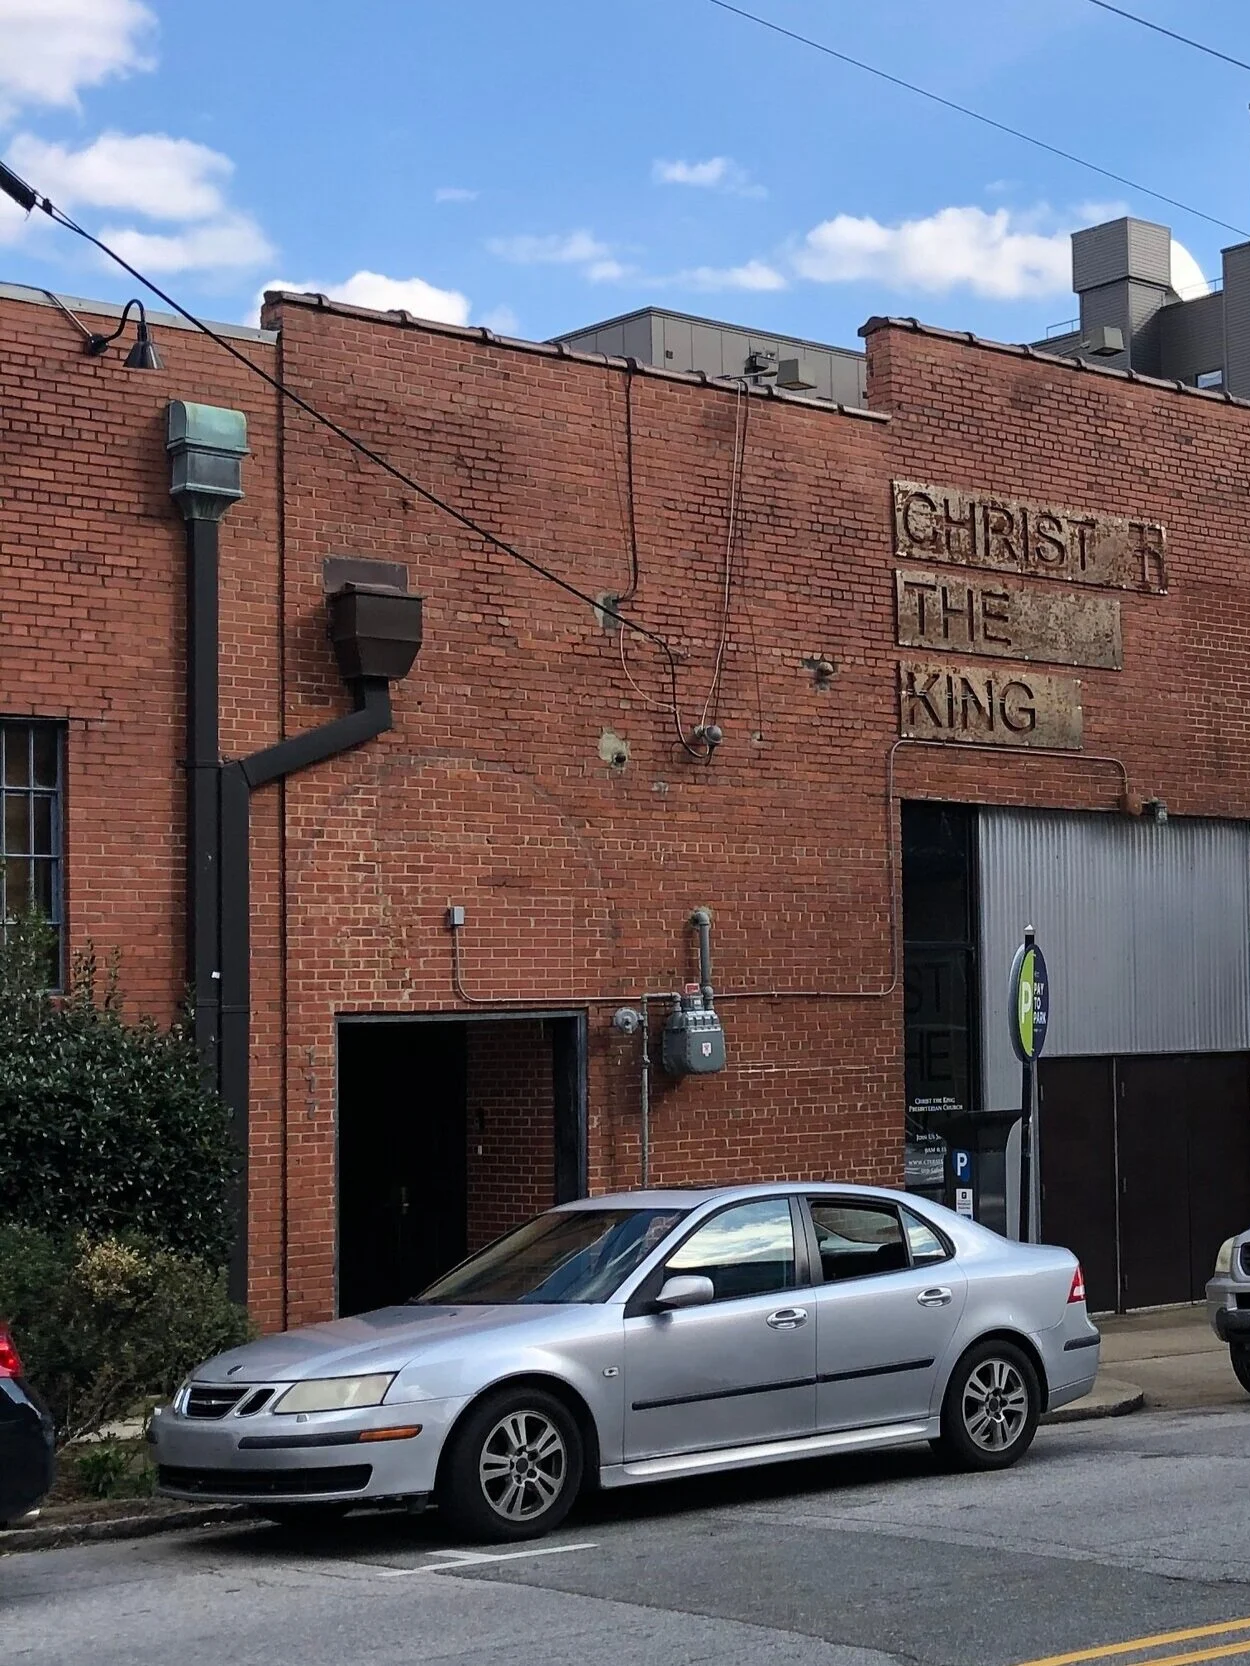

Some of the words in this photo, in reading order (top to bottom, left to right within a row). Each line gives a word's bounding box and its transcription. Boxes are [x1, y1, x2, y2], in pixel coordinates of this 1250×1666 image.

[903, 491, 1096, 571] CHRIST
[904, 580, 1011, 645] THE
[906, 671, 1036, 732] KING
[1021, 981, 1032, 1024] P
[1033, 982, 1044, 995] PAY
[1033, 996, 1042, 1010] TO
[1033, 1012, 1047, 1024] PARK
[956, 1152, 968, 1177] P
